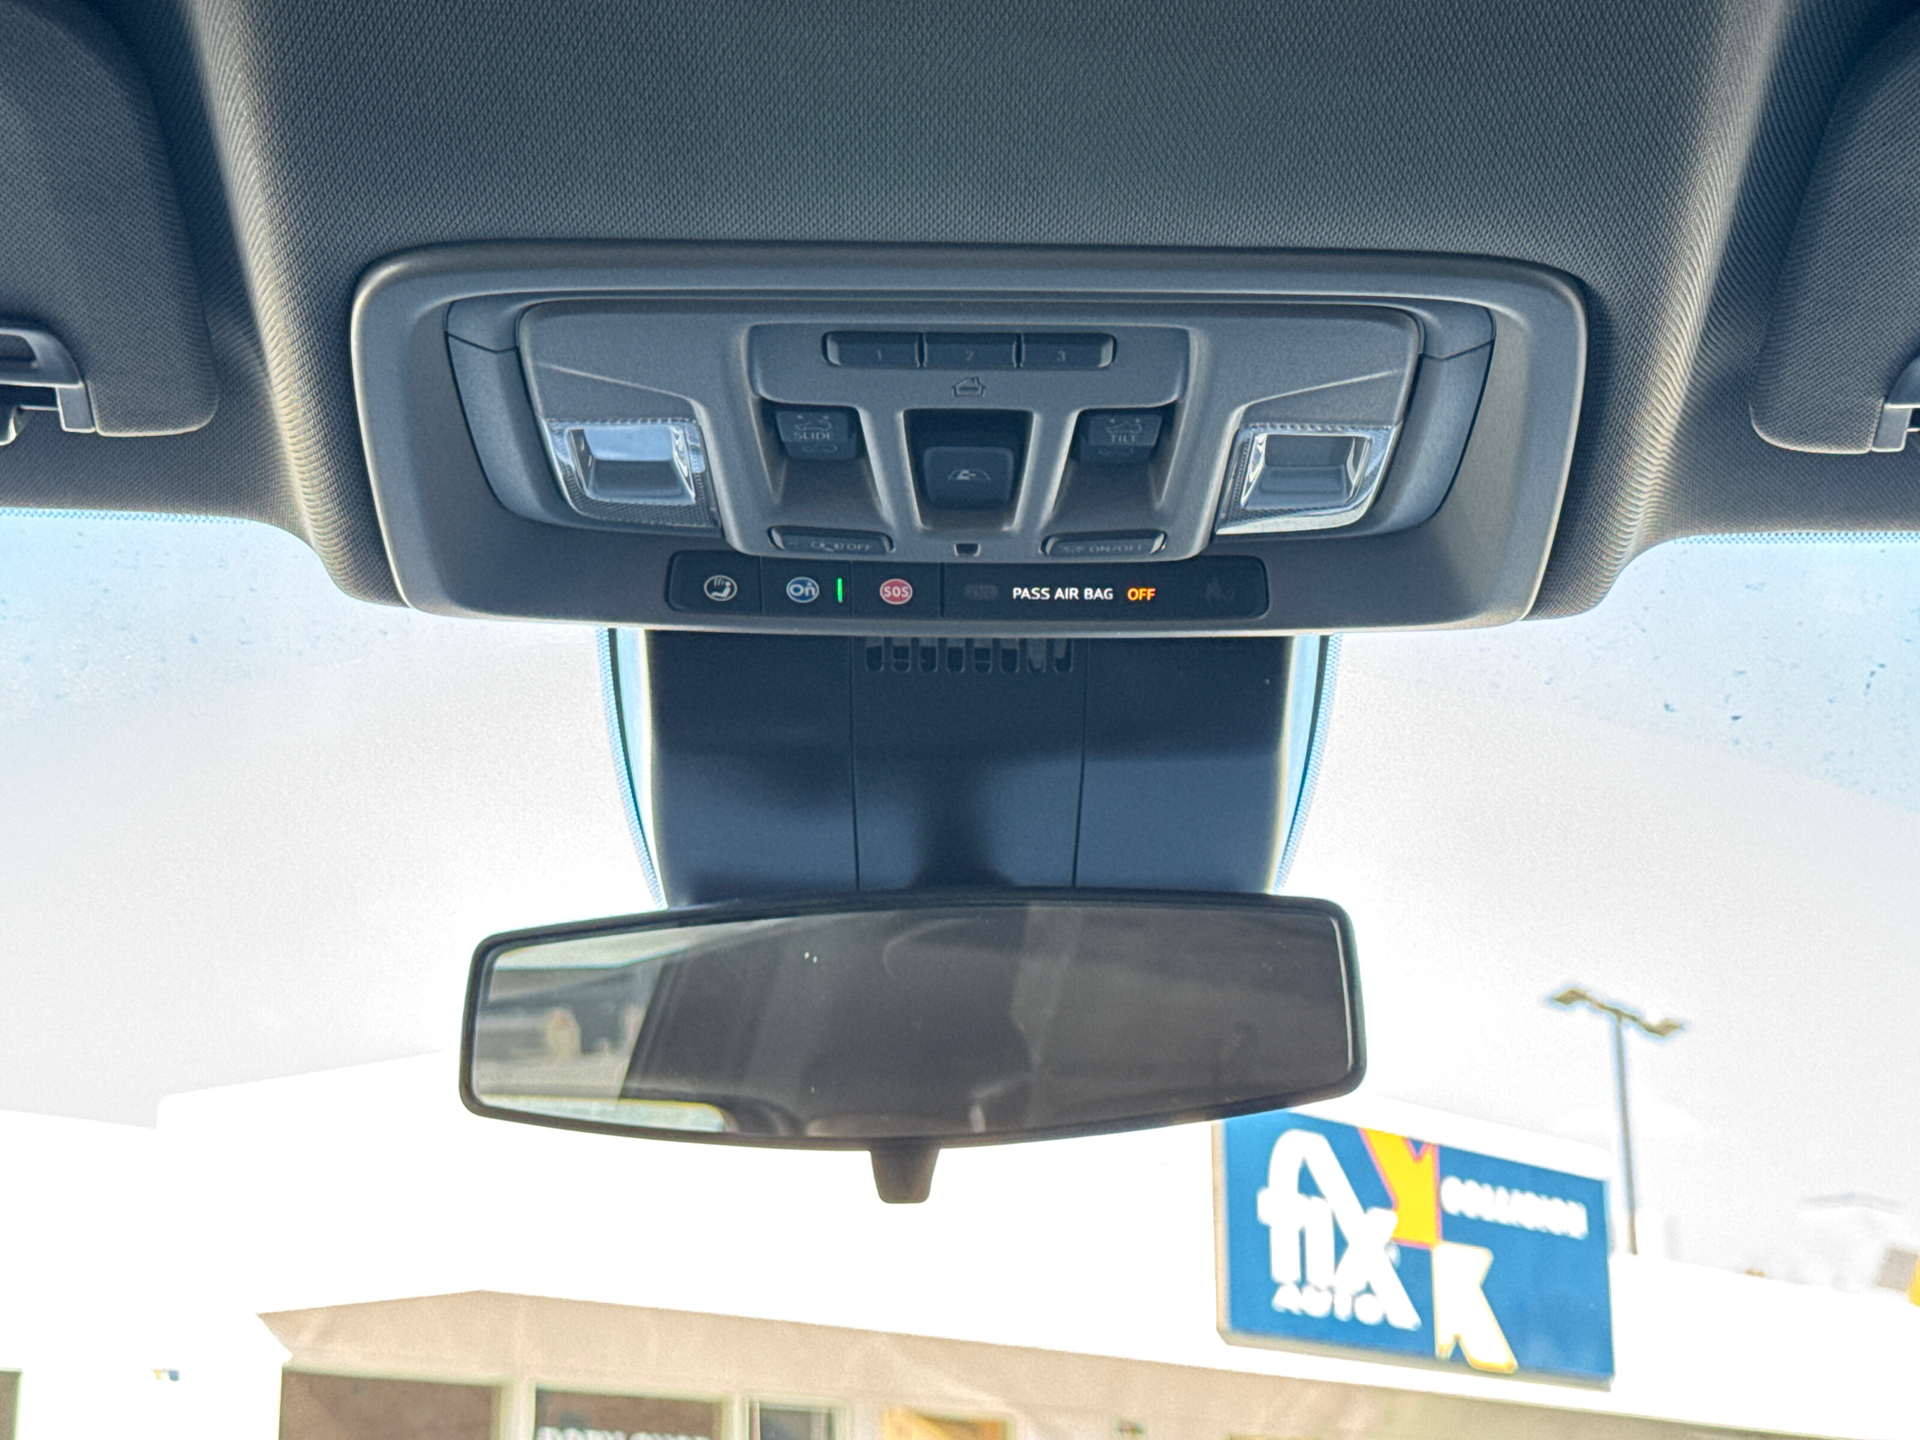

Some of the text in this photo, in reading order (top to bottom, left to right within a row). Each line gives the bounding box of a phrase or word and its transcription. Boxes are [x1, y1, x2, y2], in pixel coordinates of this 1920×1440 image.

[876, 350, 882, 361] 1
[965, 350, 974, 362] 2
[1057, 350, 1066, 362] 3
[793, 431, 832, 440] SLIDE
[1110, 434, 1138, 443] TILT
[846, 542, 873, 551] OFF
[883, 585, 909, 598] SOS
[1012, 587, 1050, 600] PASS
[1054, 587, 1079, 600] AIR
[1084, 587, 1114, 600] BAG
[1127, 587, 1156, 601] OFF
